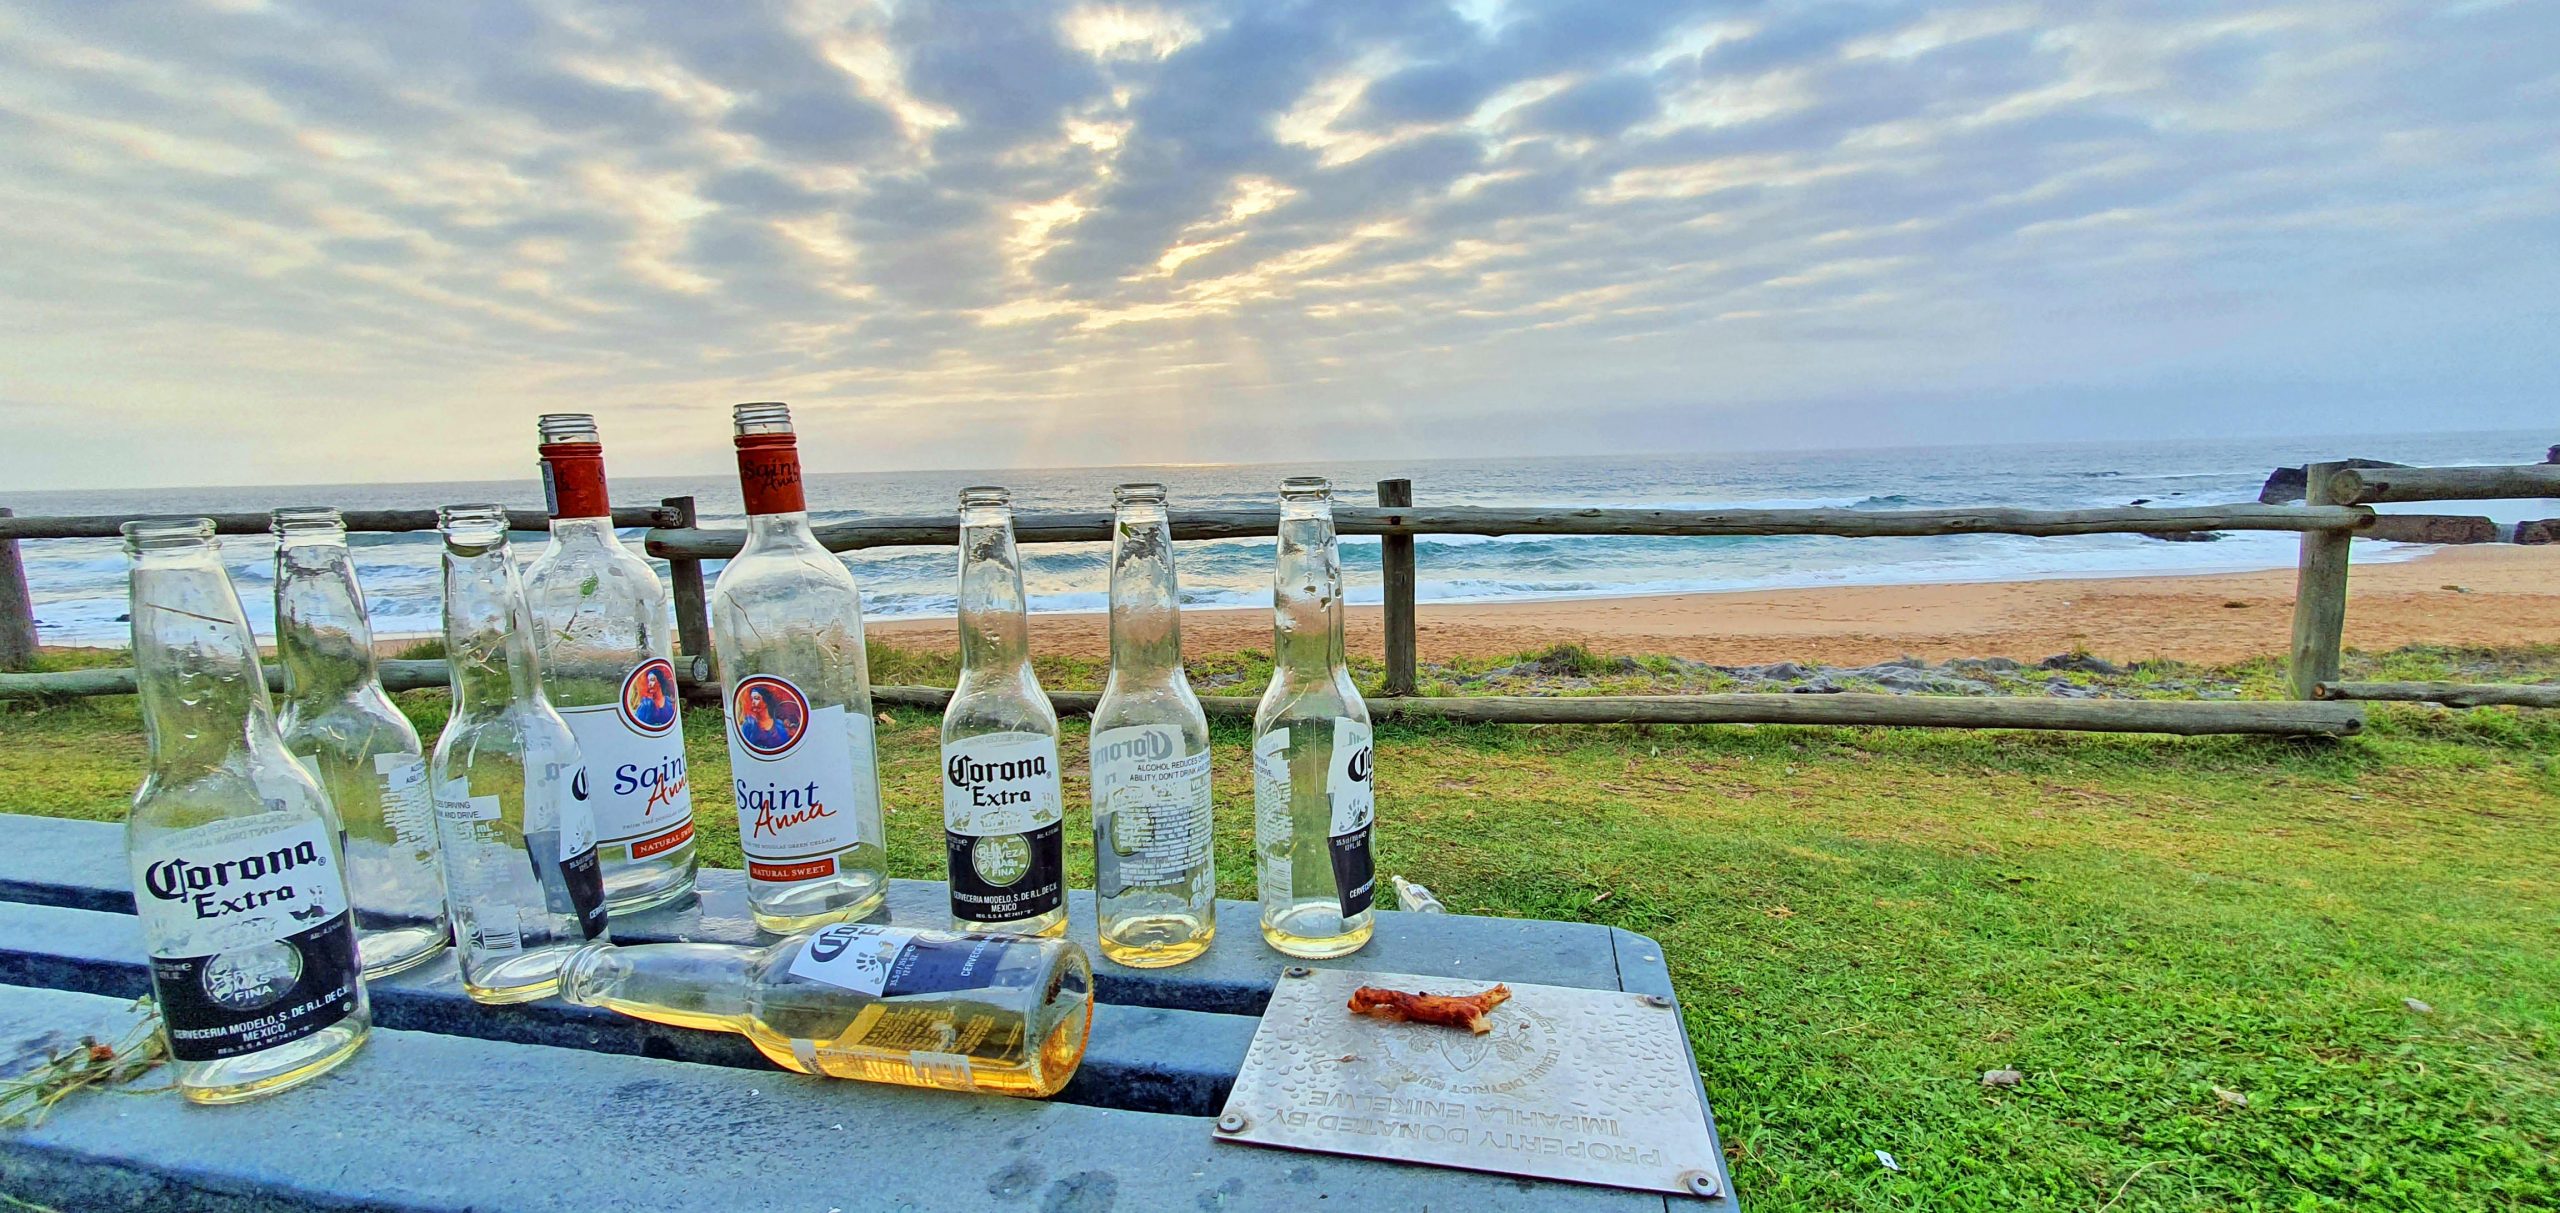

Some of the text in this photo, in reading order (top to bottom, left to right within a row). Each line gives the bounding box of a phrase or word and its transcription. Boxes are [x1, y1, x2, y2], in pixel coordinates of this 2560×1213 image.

[948, 755, 1047, 791] Corona
[1137, 763, 1170, 772] ALCOHOL
[444, 801, 471, 810] DRIVING
[736, 779, 819, 811] Saint
[971, 786, 1031, 807] Extra
[754, 799, 837, 839] Anna
[640, 834, 681, 853] NATURAL
[145, 841, 317, 904] Corona
[752, 865, 826, 877] NATURAL SWEET
[991, 867, 1016, 877] FINA
[192, 885, 296, 920] Extra
[953, 889, 983, 904] CERVECERIA
[983, 894, 1013, 905] MODELO,
[1013, 893, 1021, 902] S.
[1020, 891, 1030, 900] DE
[1041, 885, 1049, 896] DE
[991, 903, 1017, 912] MEXICO
[234, 985, 274, 1003] FINA
[173, 1023, 228, 1041] CERVECERIA
[229, 1013, 279, 1035] MODELO,
[279, 1009, 291, 1022] S.
[291, 1003, 306, 1019] DE
[306, 996, 325, 1013] R.L.
[325, 991, 337, 1007] DE
[243, 1022, 286, 1043] MEXICO
[1449, 1078, 1527, 1096] DISTRICT
[1308, 1090, 1619, 1137] IMPAHLA ENIKELWE
[1268, 1109, 1663, 1168] PROPERTY DONATED BY
